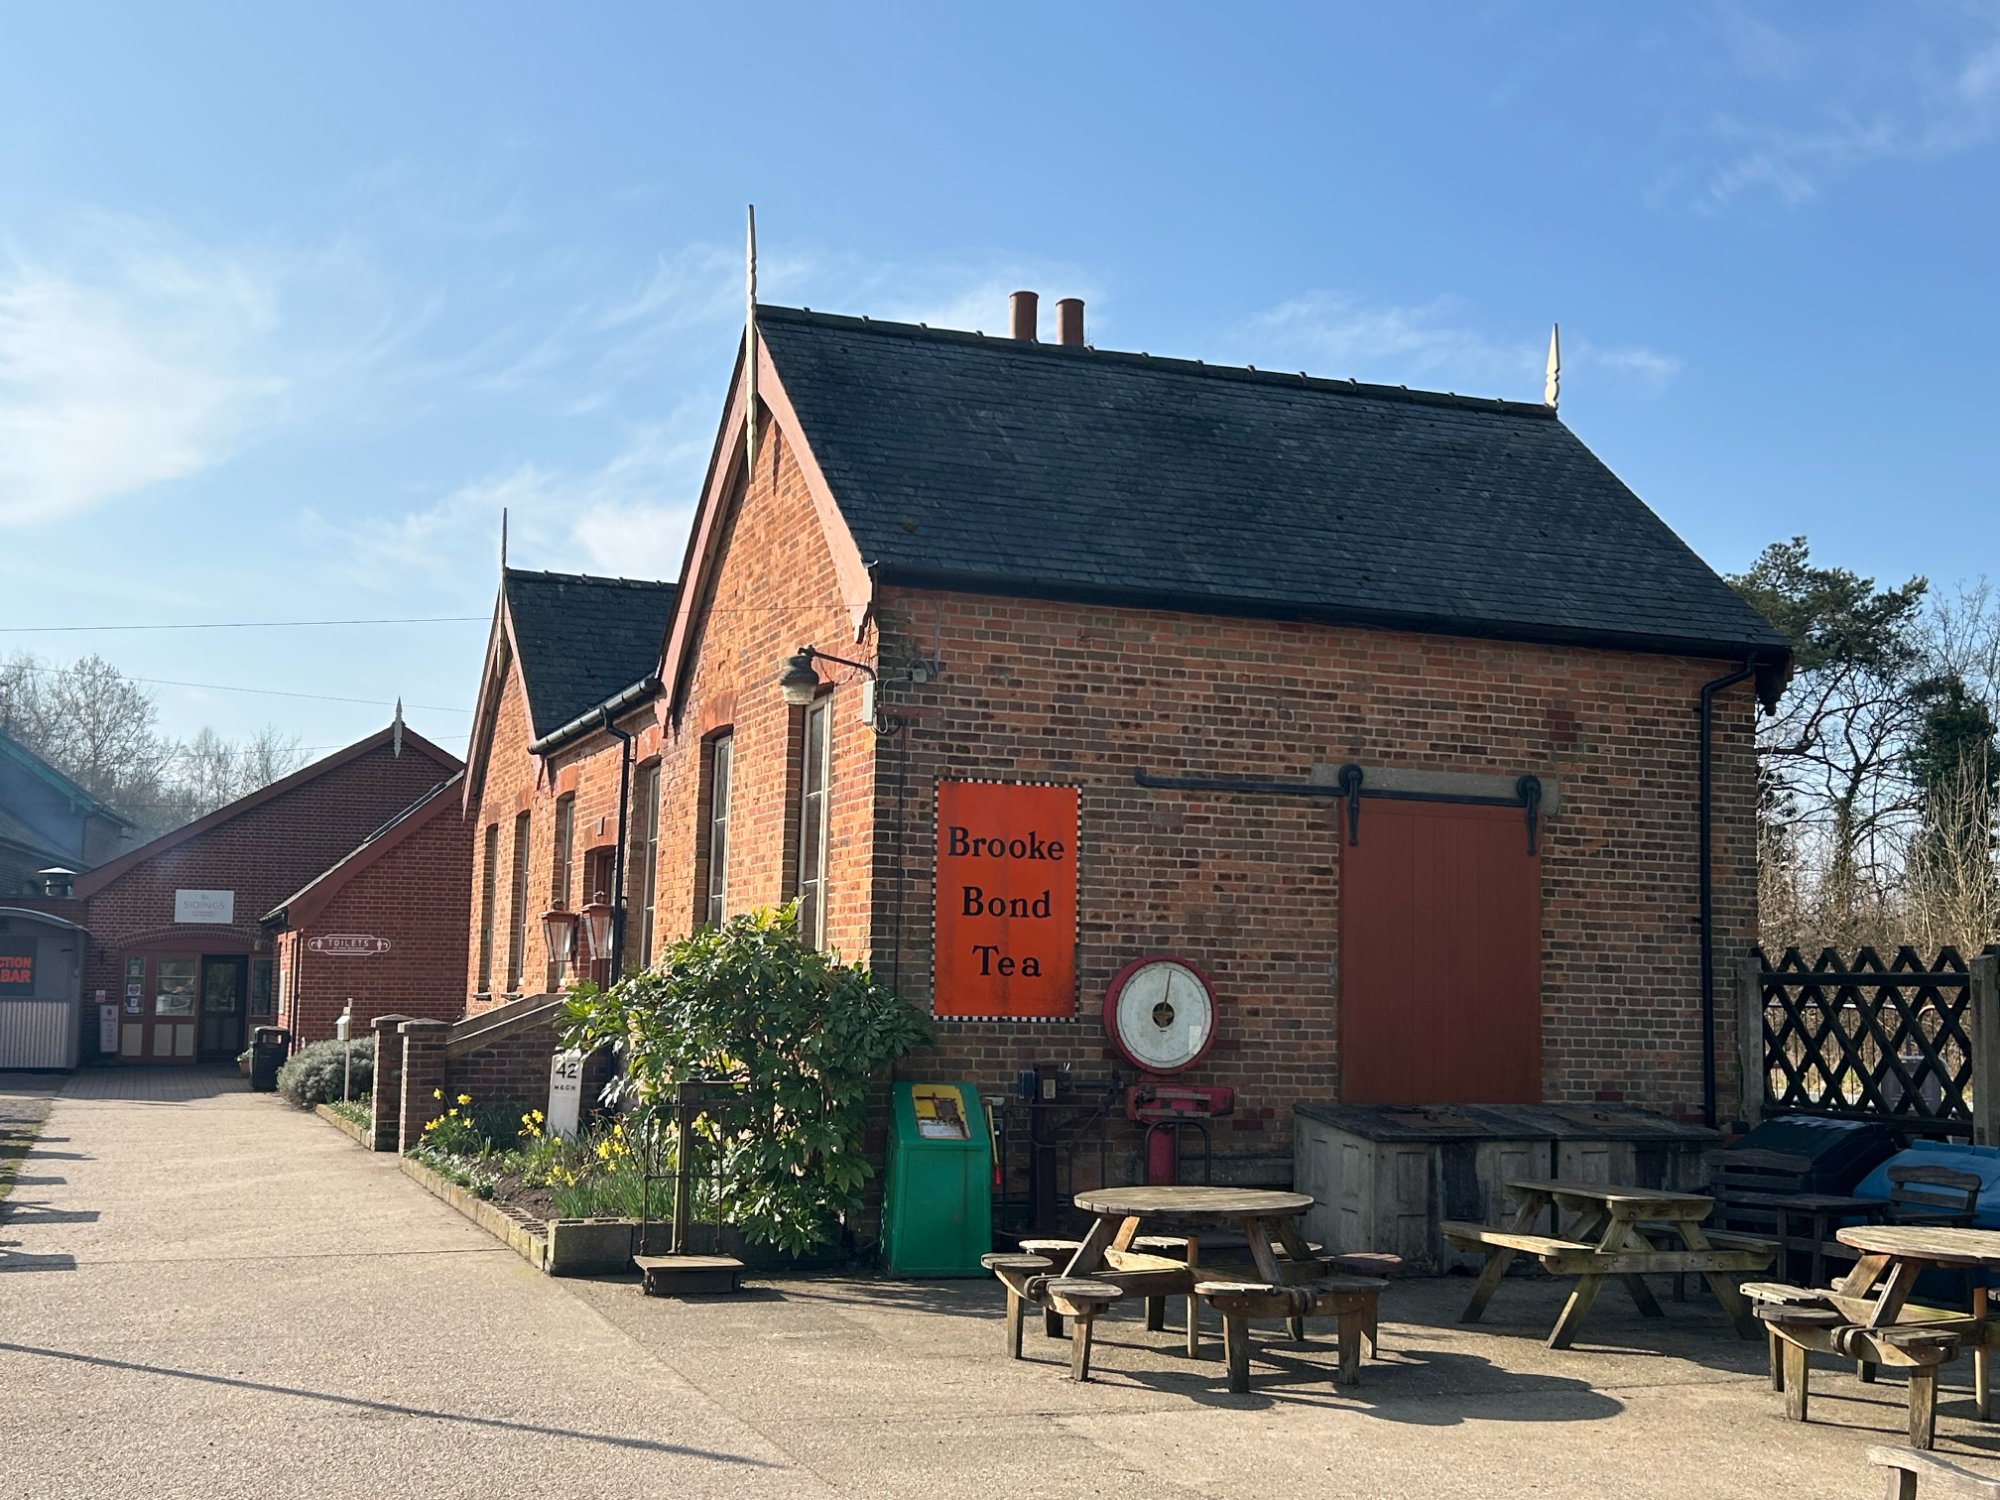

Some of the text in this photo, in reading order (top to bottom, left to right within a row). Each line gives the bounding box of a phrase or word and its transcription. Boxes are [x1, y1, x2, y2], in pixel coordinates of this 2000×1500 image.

[948, 826, 1064, 861] Brooke
[183, 901, 225, 910] SIDINGS
[961, 886, 1051, 918] Bond
[972, 945, 1042, 977] Tea
[1, 969, 31, 983] BAR
[555, 1062, 577, 1079] 42
